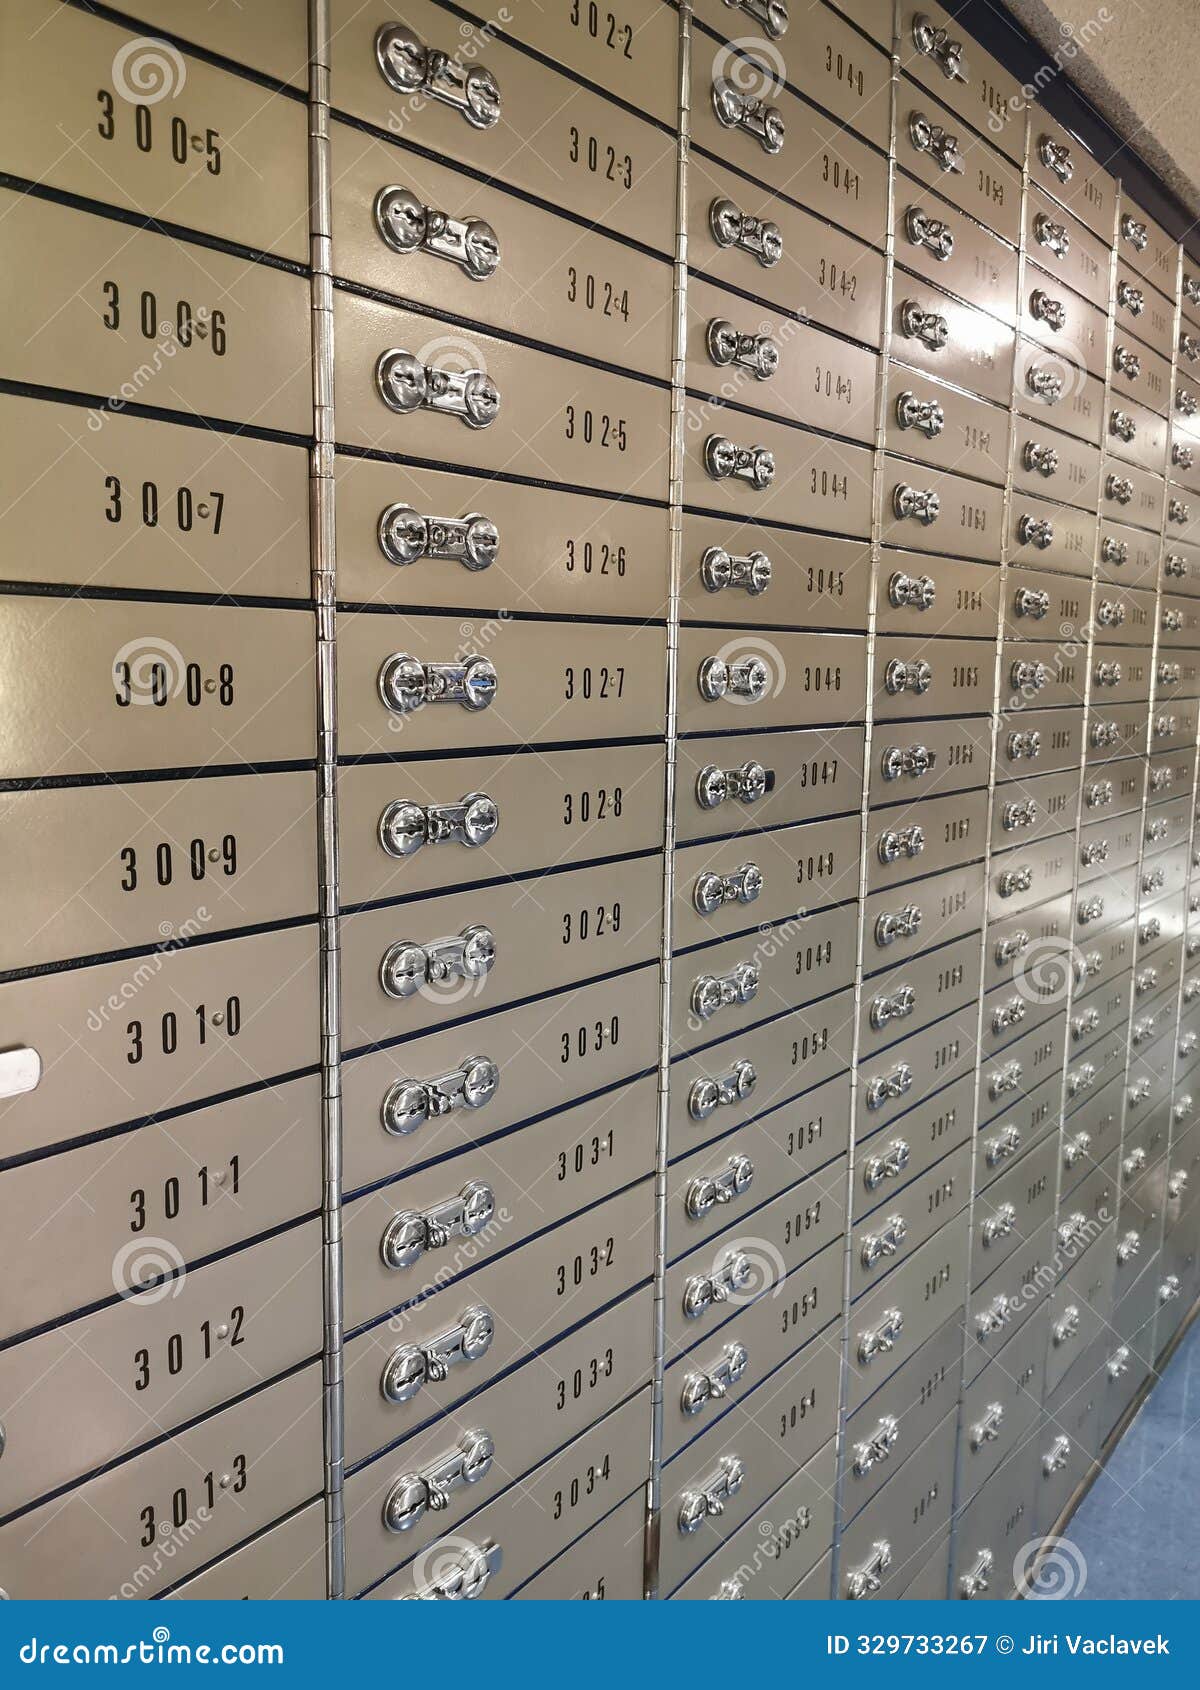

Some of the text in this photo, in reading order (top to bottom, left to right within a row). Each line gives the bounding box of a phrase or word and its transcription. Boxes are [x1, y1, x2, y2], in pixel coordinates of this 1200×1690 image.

[571, 0, 632, 59] 3022
[826, 45, 863, 96] 3040
[97, 90, 220, 175] 3005
[570, 127, 631, 189] 3023
[823, 155, 858, 200] 3041
[568, 267, 629, 322] 3024
[819, 259, 856, 301] 3042
[103, 281, 225, 356] 3006
[815, 367, 851, 404] 3043
[566, 406, 626, 451] 3025
[105, 476, 224, 534] 3007
[811, 468, 847, 500] 3044
[961, 505, 985, 531] 3063
[566, 540, 625, 576] 3026
[808, 568, 843, 596] 3045
[957, 590, 982, 611] 3064
[115, 662, 234, 707] 3008
[566, 668, 624, 699] 3027
[805, 667, 840, 691] 3046
[953, 667, 978, 687] 3065
[801, 760, 837, 787] 3047
[564, 788, 622, 824] 3028
[945, 818, 969, 843] 3067
[121, 835, 236, 891] 3009
[797, 853, 833, 883] 3048
[563, 903, 620, 944] 3029
[796, 941, 831, 975] 3049
[127, 996, 240, 1064] 3010
[561, 1016, 618, 1063] 3030
[792, 1028, 827, 1065] 3050
[558, 1130, 612, 1181] 3031
[788, 1117, 822, 1155] 3051
[131, 1156, 238, 1232] 3011
[785, 1201, 820, 1244] 3052
[557, 1238, 613, 1295] 3032
[782, 1287, 817, 1333] 3053
[135, 1306, 244, 1390] 3012
[557, 1349, 613, 1410] 3033
[781, 1389, 815, 1437] 3054
[140, 1455, 247, 1548] 3013
[554, 1454, 610, 1520] 3034
